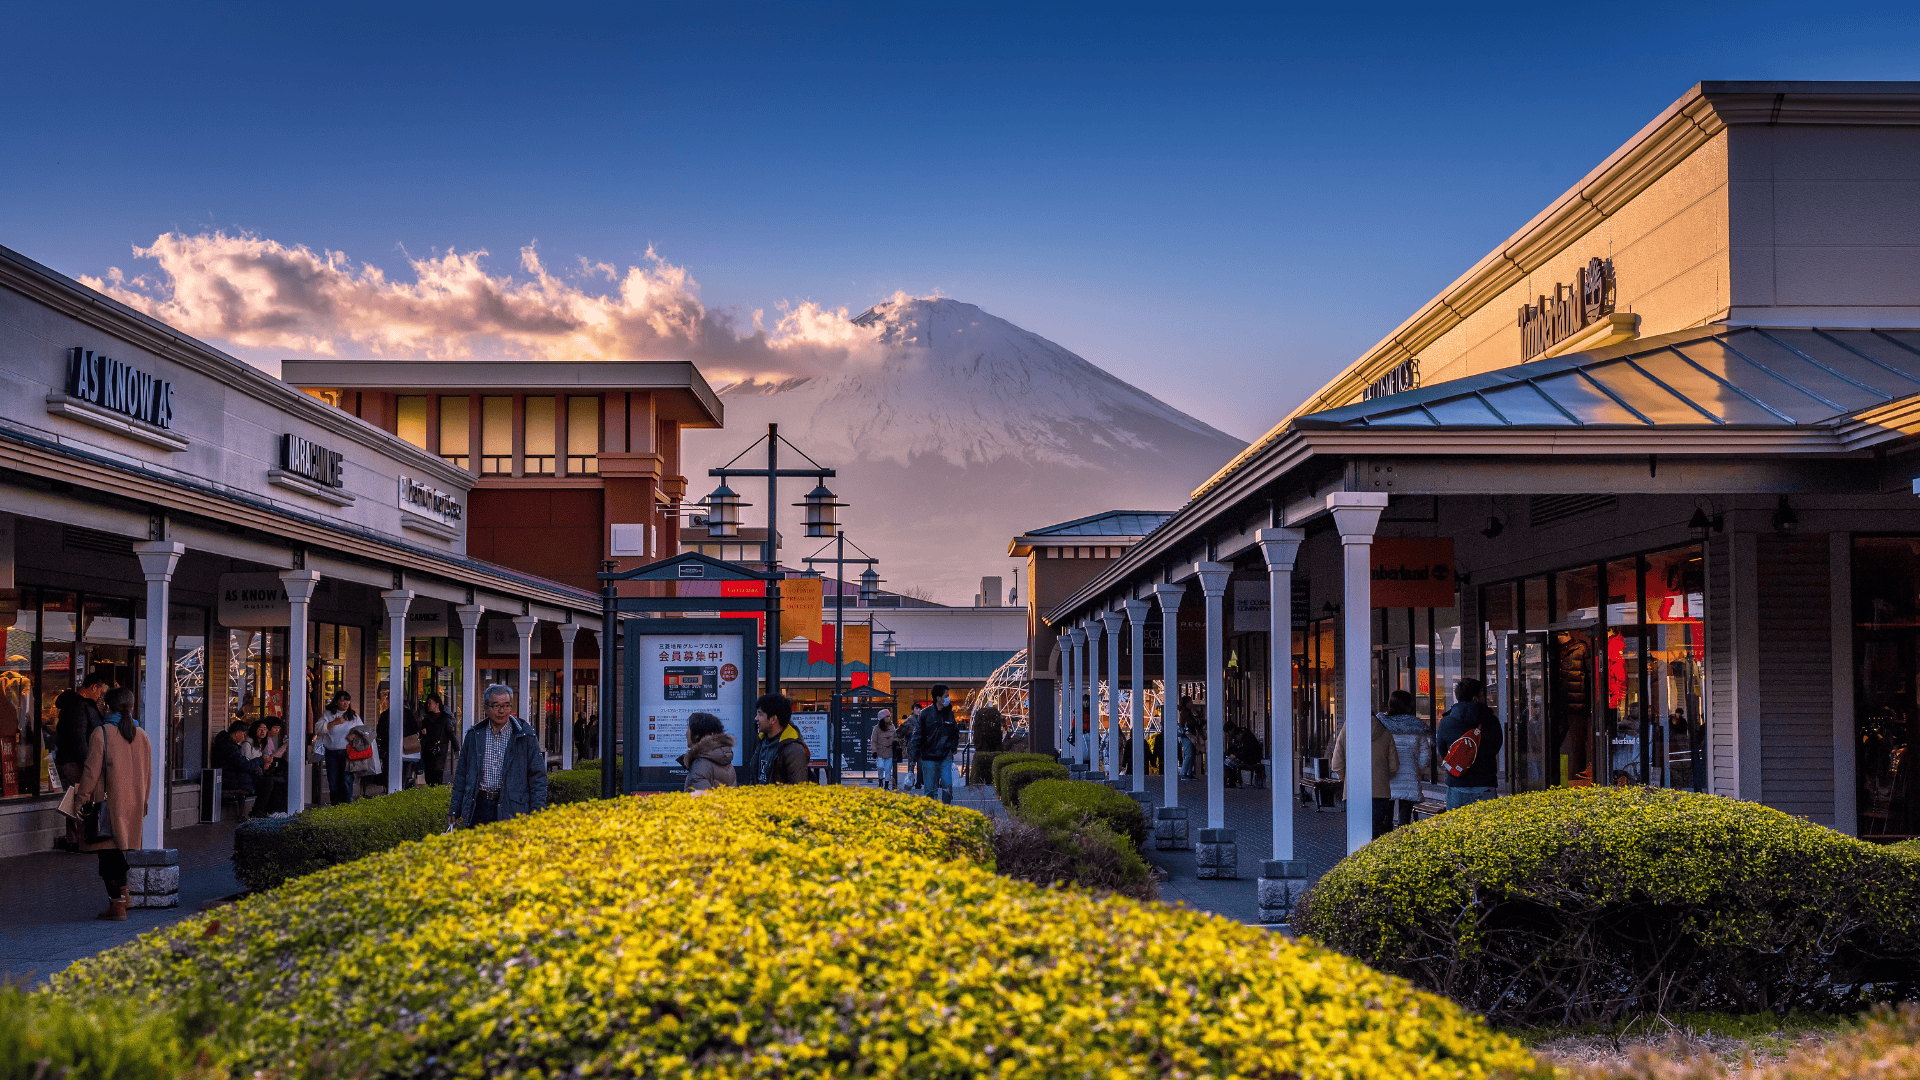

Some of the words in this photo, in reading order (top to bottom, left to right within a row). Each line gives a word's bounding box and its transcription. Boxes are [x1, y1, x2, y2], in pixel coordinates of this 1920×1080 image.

[1517, 267, 1585, 364] Timberland
[73, 347, 98, 402] AS
[101, 357, 155, 422] KNOW
[156, 380, 176, 429] AS
[225, 590, 238, 602] AS
[241, 589, 278, 602] KNOW
[281, 589, 290, 601] A
[1370, 564, 1430, 580] mberland
